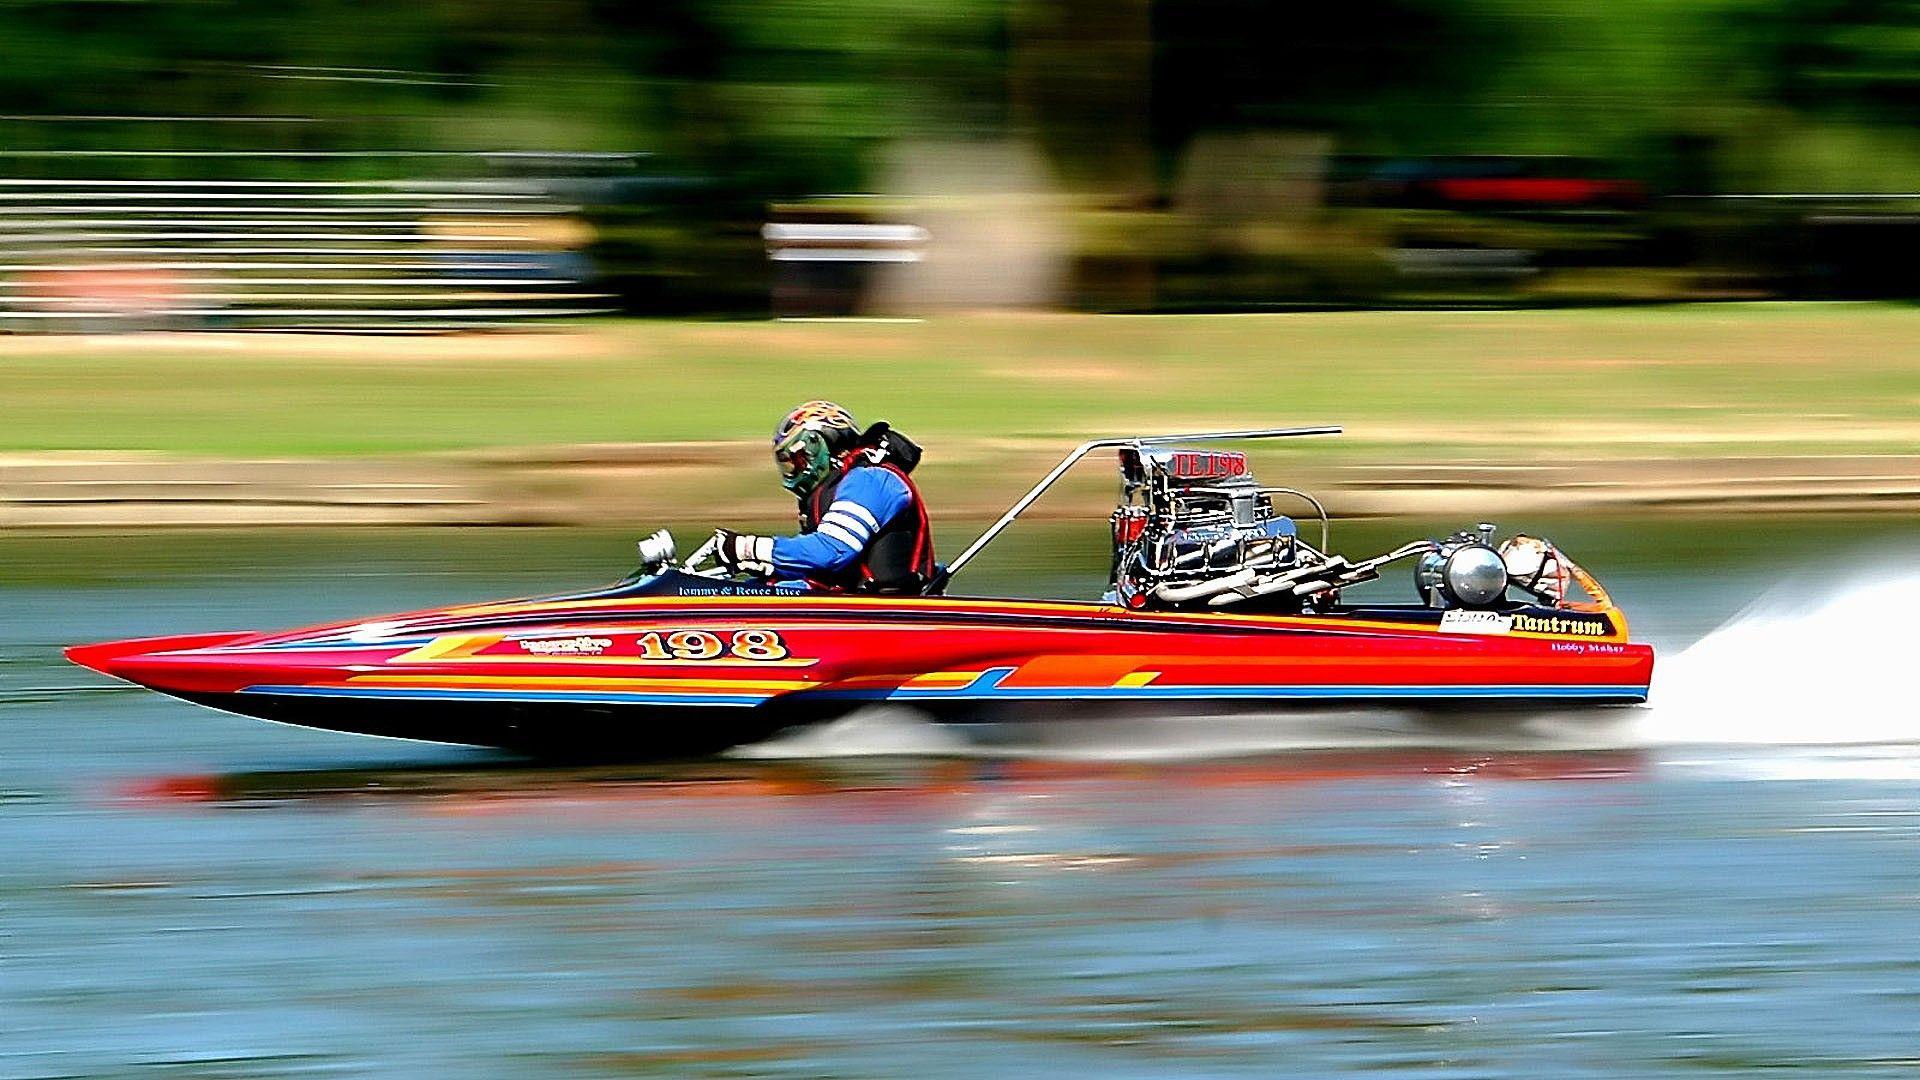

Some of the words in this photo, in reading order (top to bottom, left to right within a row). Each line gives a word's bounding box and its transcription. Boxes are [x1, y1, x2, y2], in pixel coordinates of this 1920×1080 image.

[679, 586, 718, 597] Tommy
[720, 586, 732, 596] &
[736, 586, 771, 597] Renee
[775, 587, 801, 597] Rice
[1511, 613, 1605, 636] Tantrum
[636, 630, 788, 661] 198
[1551, 642, 1585, 655] Hobby
